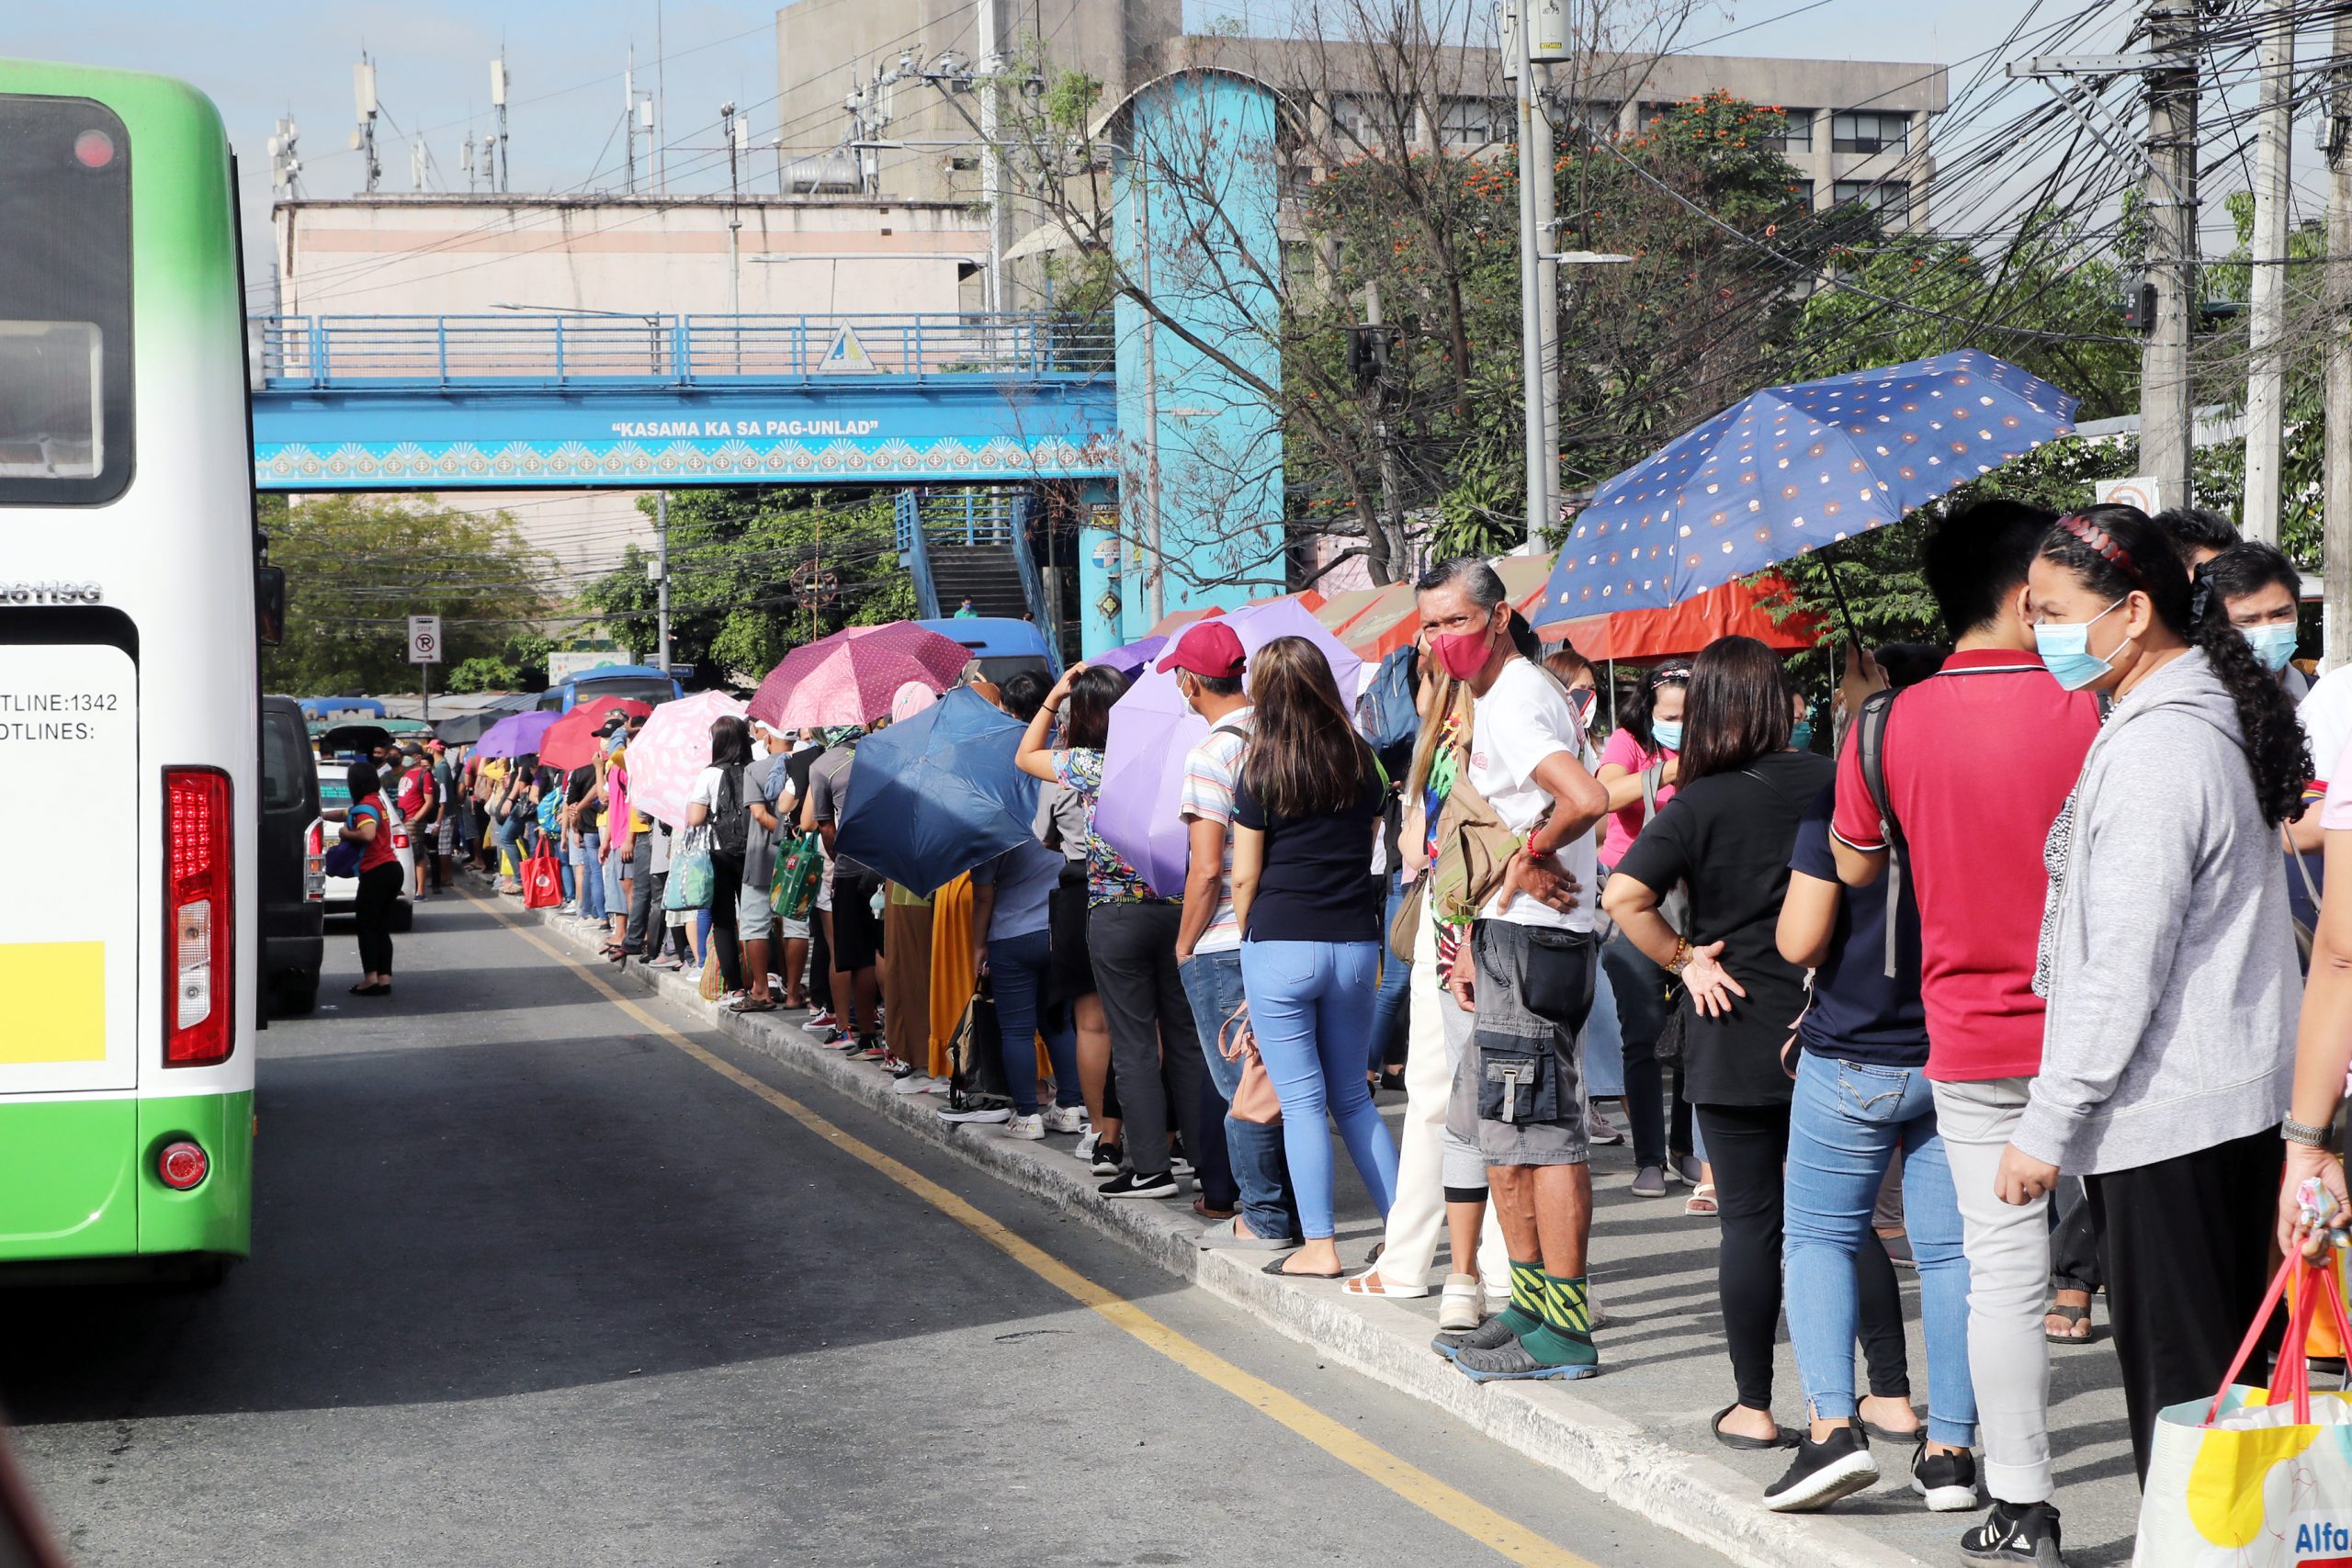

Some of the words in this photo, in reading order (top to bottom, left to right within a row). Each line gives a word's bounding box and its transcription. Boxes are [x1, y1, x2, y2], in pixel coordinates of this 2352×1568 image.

[706, 423, 730, 436] KA
[737, 422, 761, 435] SA
[2295, 1522, 2352, 1553] Alfa
